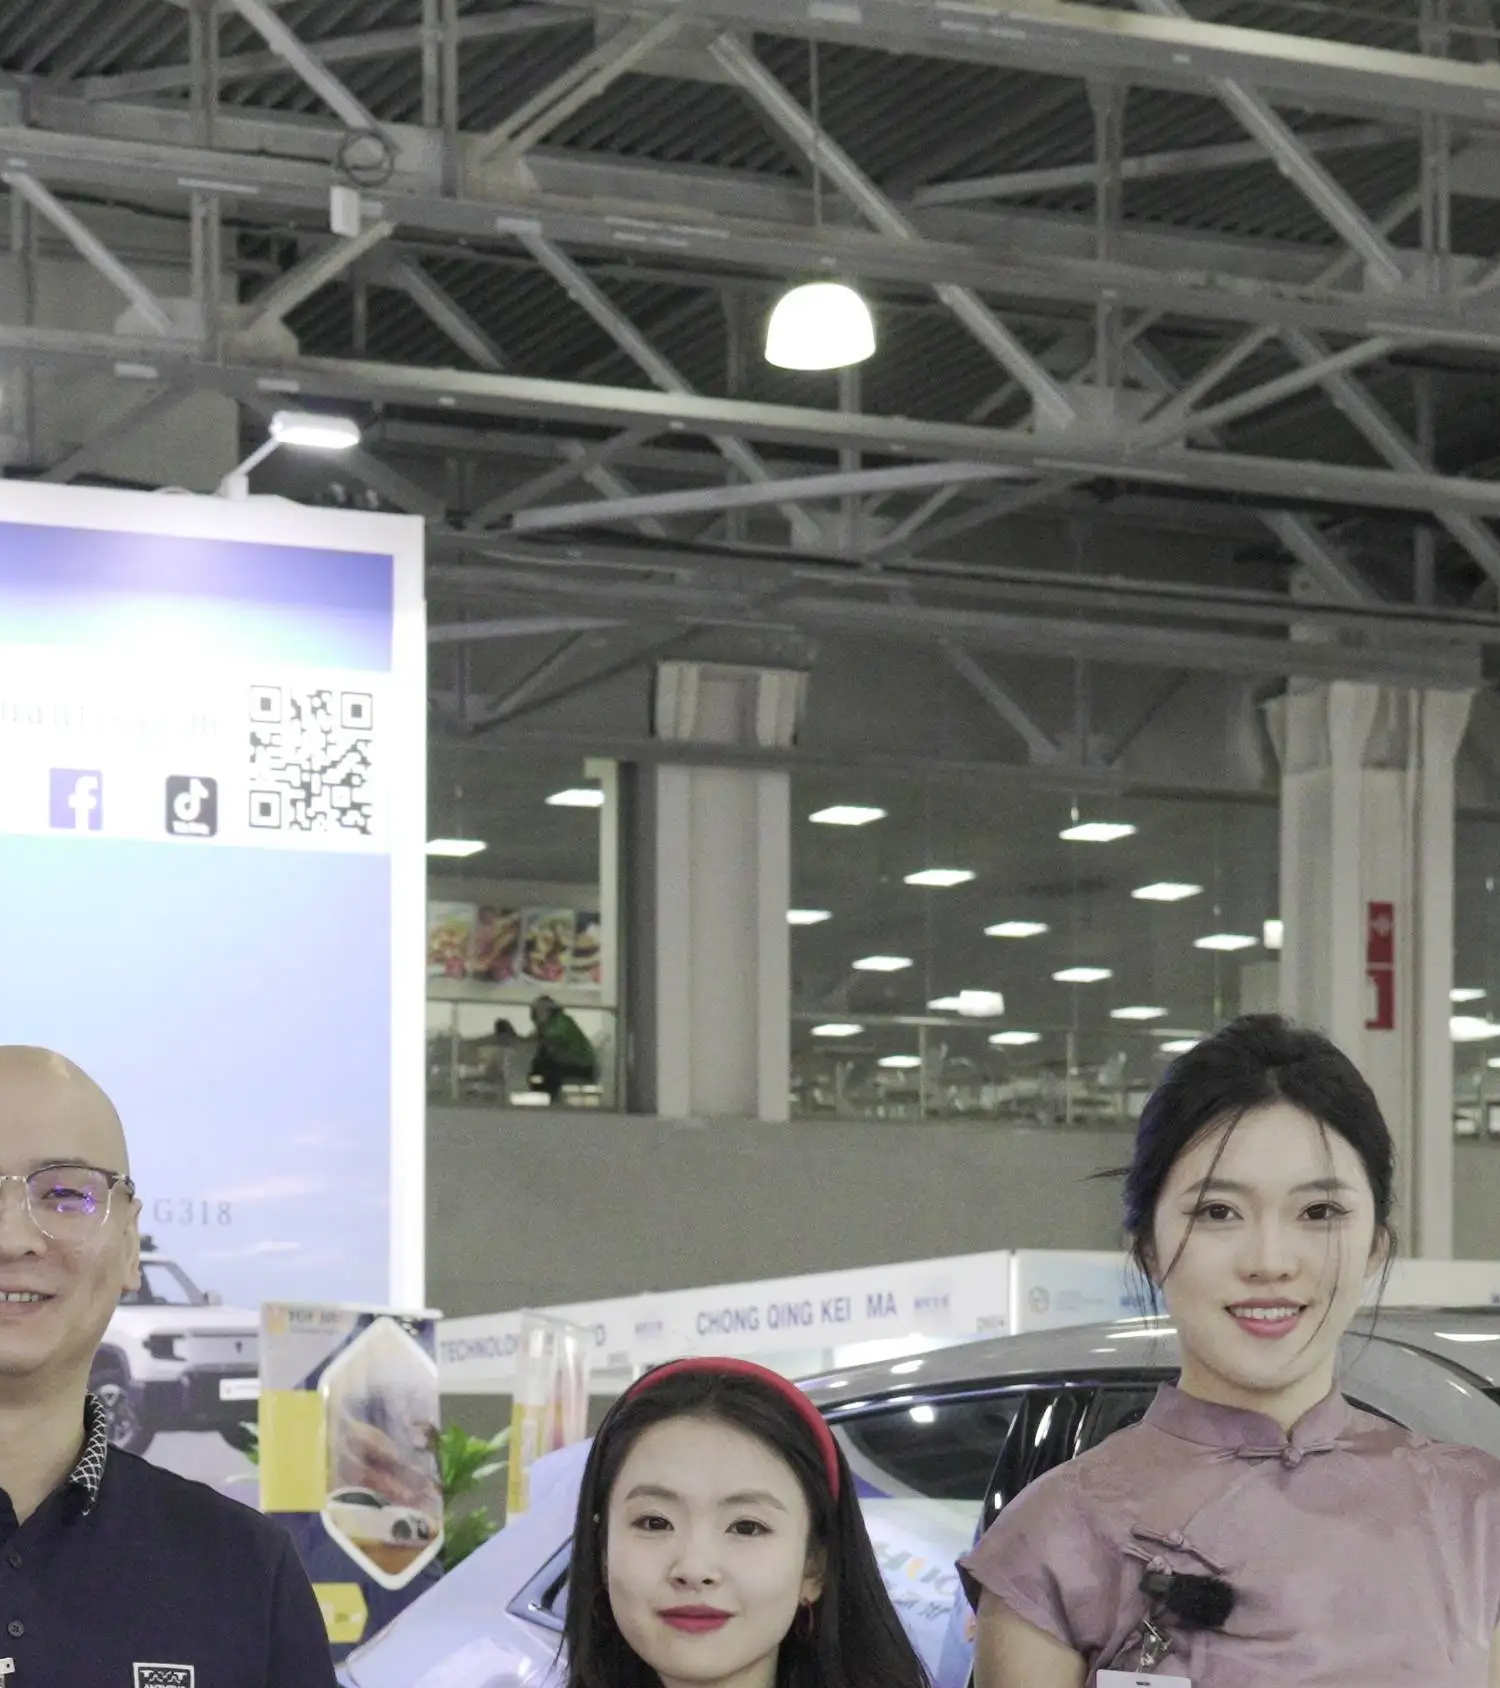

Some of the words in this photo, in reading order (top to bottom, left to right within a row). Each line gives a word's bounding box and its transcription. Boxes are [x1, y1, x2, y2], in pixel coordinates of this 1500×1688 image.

[153, 1198, 232, 1226] G318
[696, 1306, 760, 1335] CHONG
[766, 1302, 813, 1329] QING
[820, 1297, 852, 1323] KEI
[866, 1292, 897, 1318] MA
[439, 1333, 520, 1363] TECHNOLO
